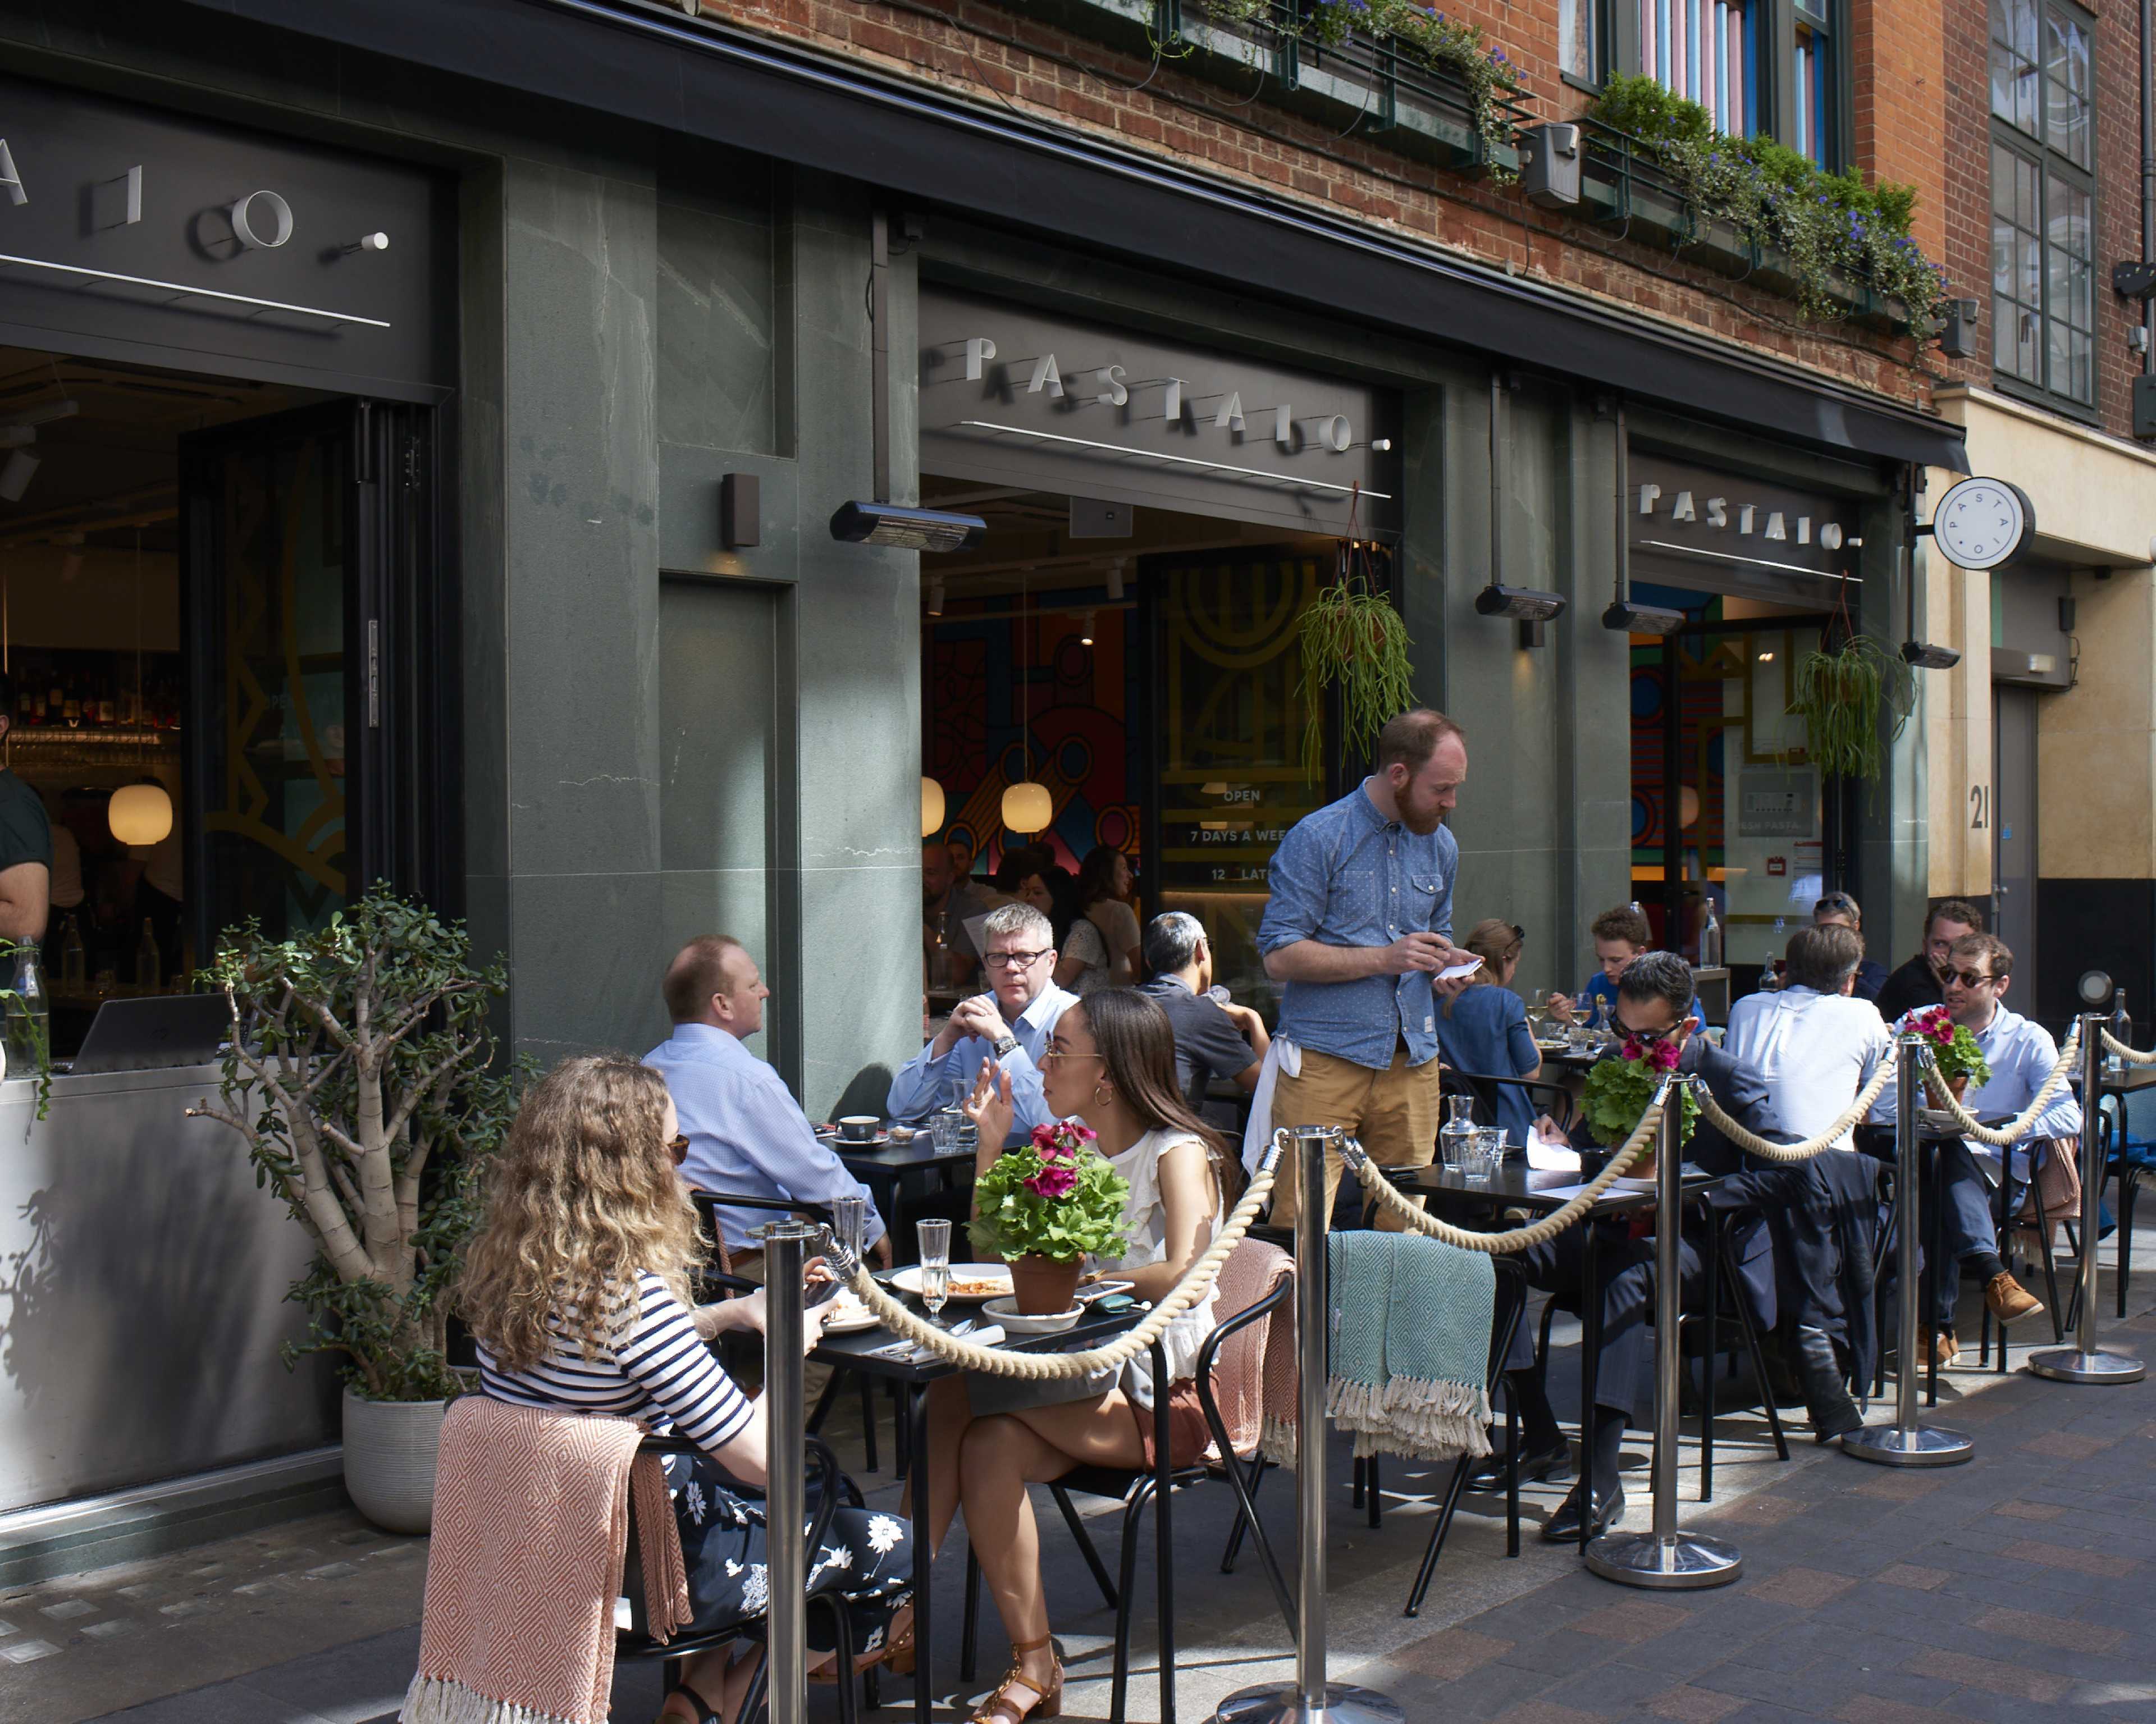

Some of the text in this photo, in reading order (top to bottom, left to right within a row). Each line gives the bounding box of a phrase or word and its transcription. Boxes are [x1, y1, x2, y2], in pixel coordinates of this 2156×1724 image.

[1224, 790, 1260, 801] OPEN
[1970, 785, 1988, 829] 21
[1190, 830, 1286, 841] 7 DAYS A WEE
[1212, 869, 1225, 880] 12
